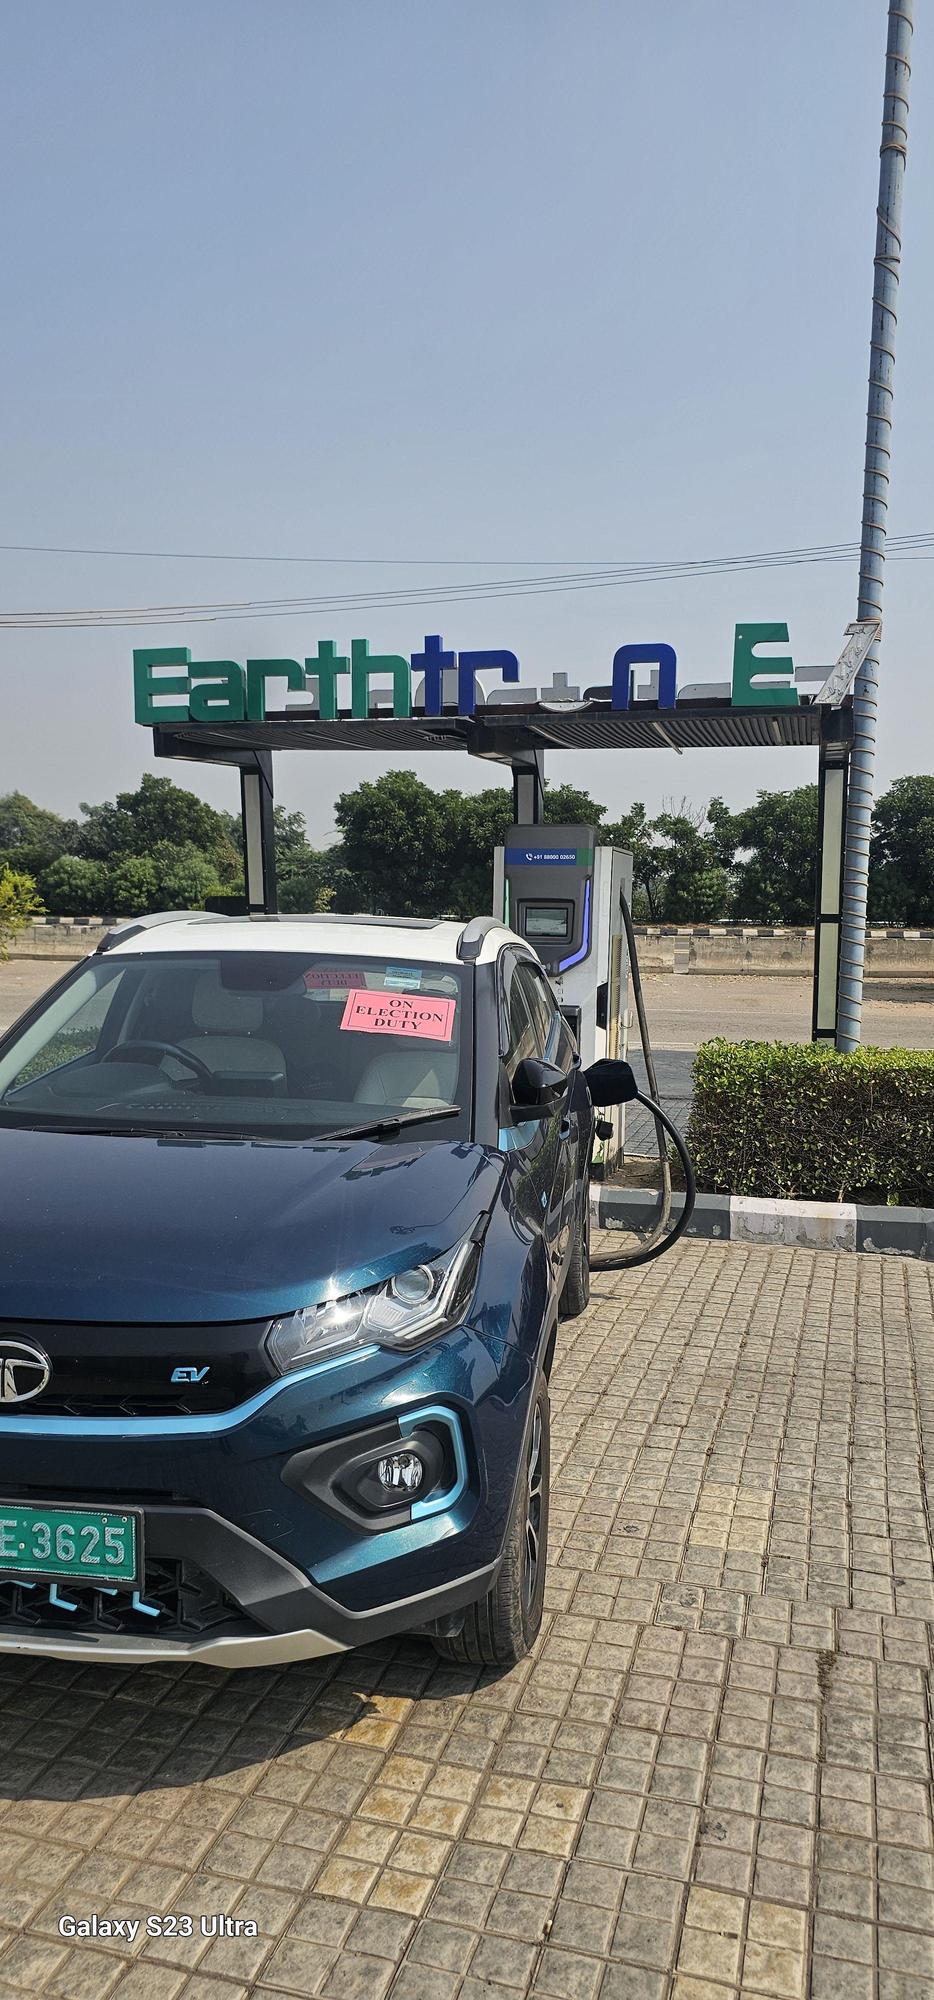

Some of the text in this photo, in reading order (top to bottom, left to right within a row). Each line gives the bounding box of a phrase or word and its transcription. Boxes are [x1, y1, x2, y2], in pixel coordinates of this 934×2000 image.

[389, 999, 414, 1009] ON
[355, 1005, 444, 1022] ELECTION
[374, 1018, 422, 1030] DUTY
[171, 1366, 210, 1383] EV
